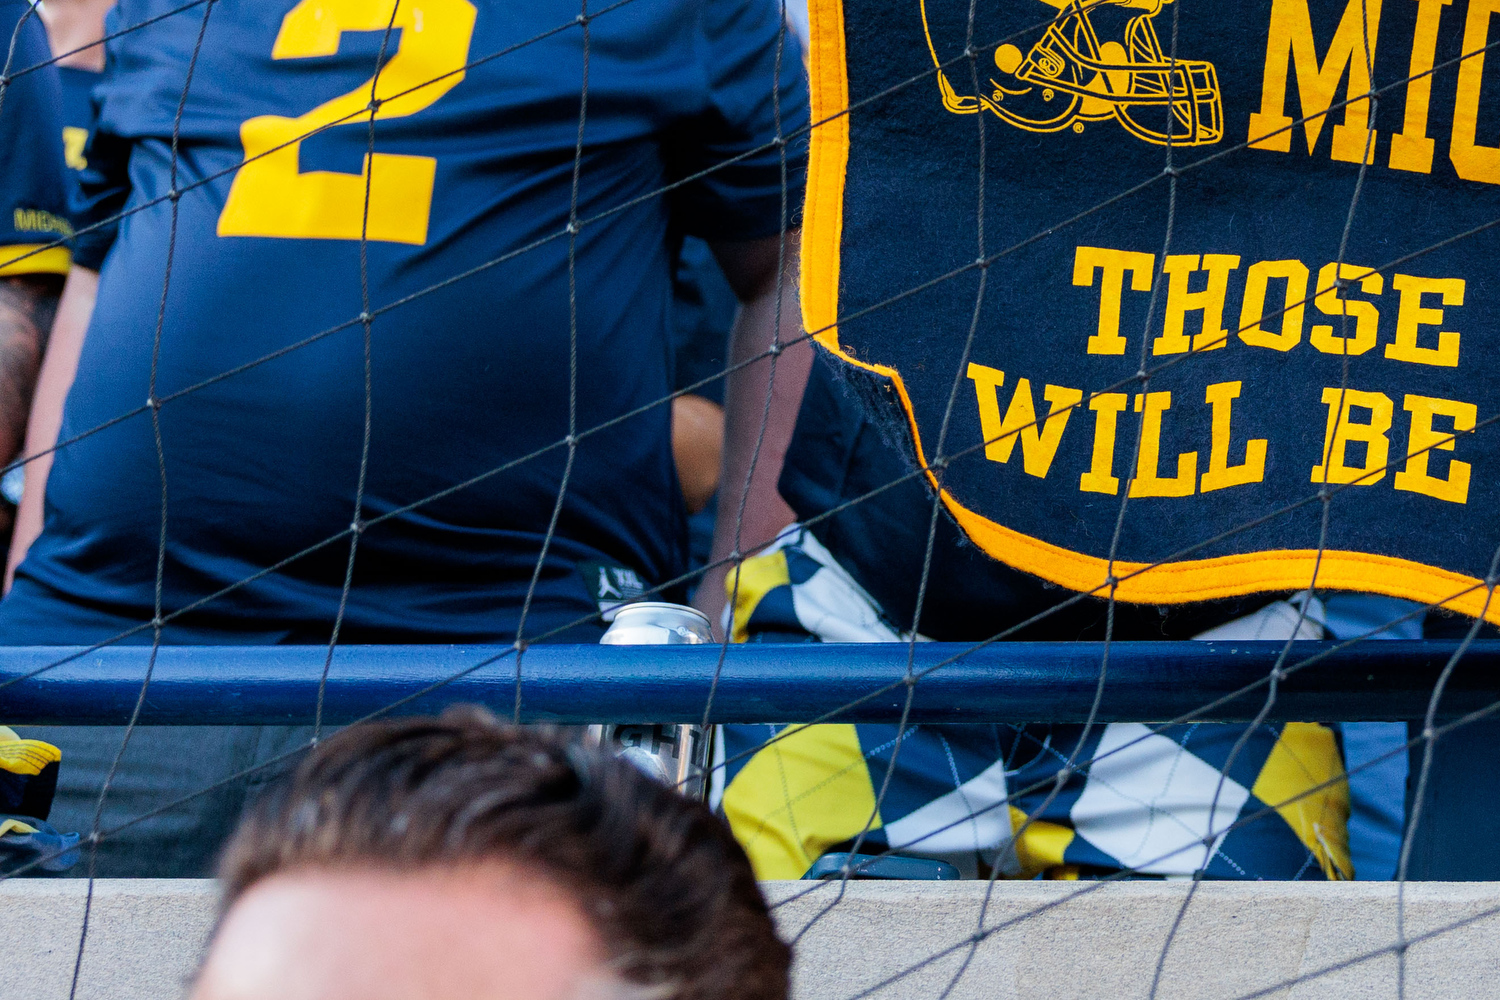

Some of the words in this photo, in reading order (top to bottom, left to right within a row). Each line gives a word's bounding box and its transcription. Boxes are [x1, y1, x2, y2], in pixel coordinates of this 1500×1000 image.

[1072, 246, 1465, 366] THOSE
[966, 362, 1267, 499] WILL
[1311, 387, 1478, 504] BE
